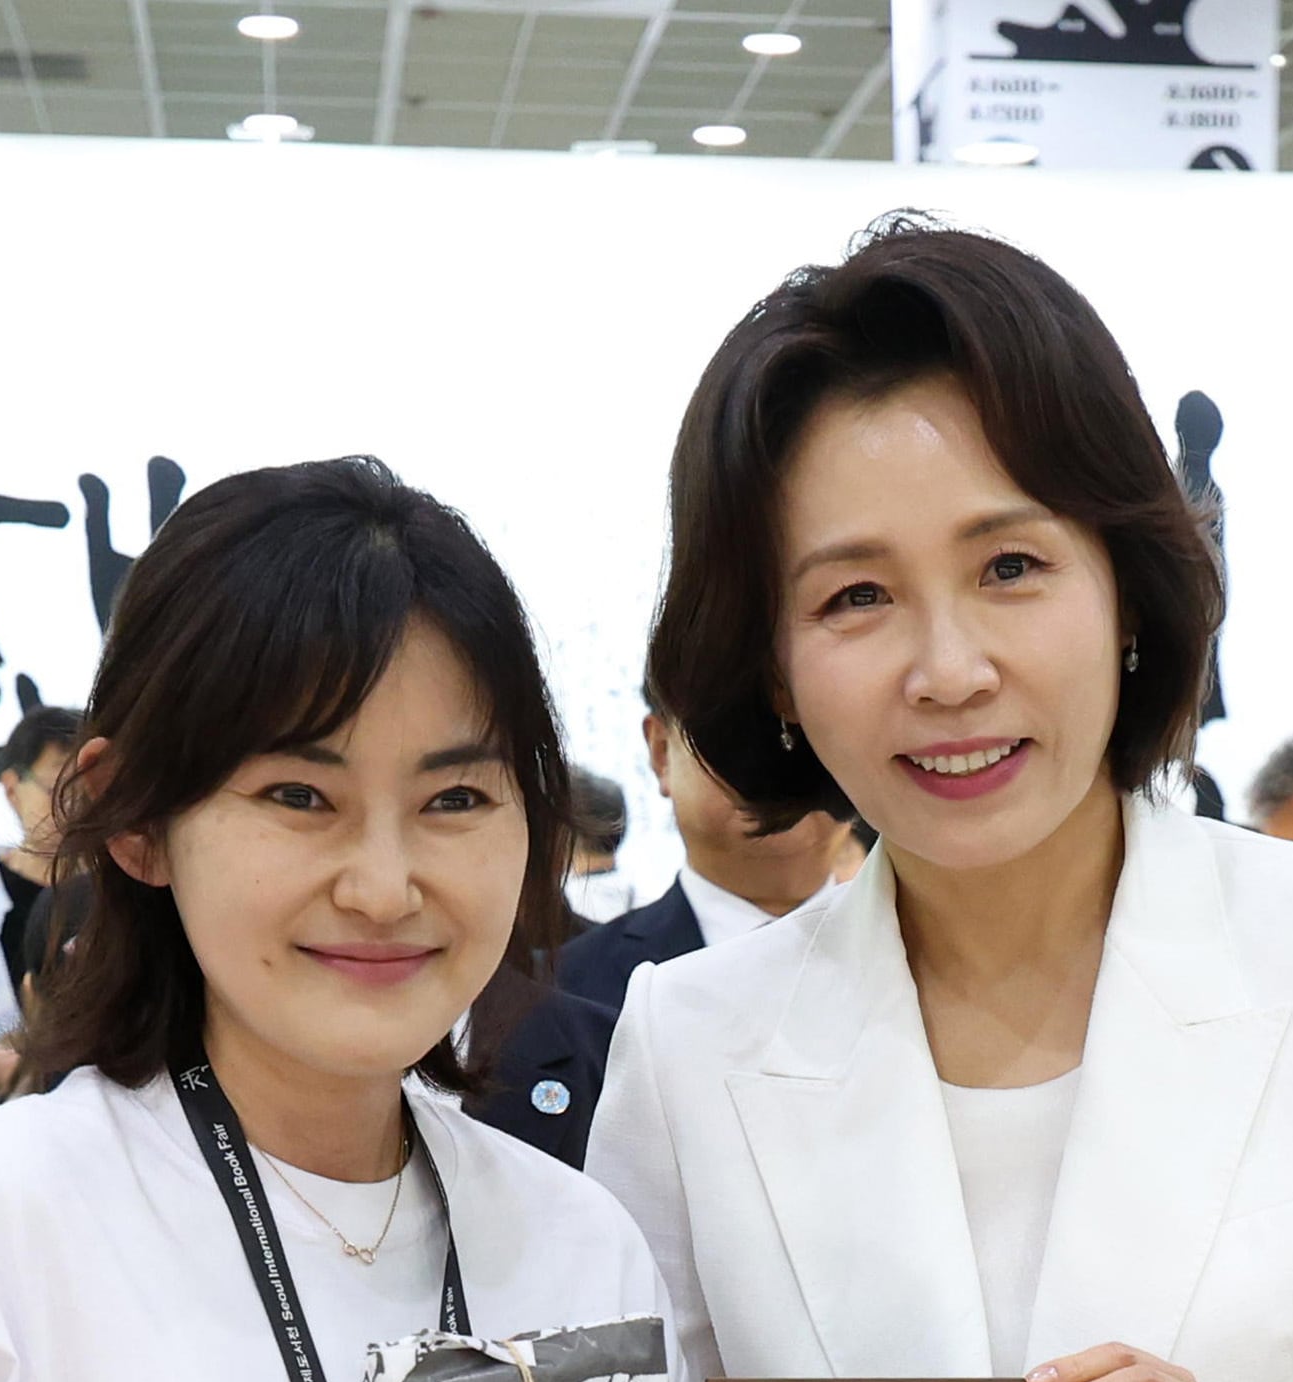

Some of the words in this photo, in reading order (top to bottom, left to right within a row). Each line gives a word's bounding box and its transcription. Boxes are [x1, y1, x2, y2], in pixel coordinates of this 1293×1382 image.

[213, 1122, 232, 1151] Fair
[224, 1149, 247, 1187] Book
[237, 1186, 283, 1278] International
[270, 1276, 294, 1322] Seoul
